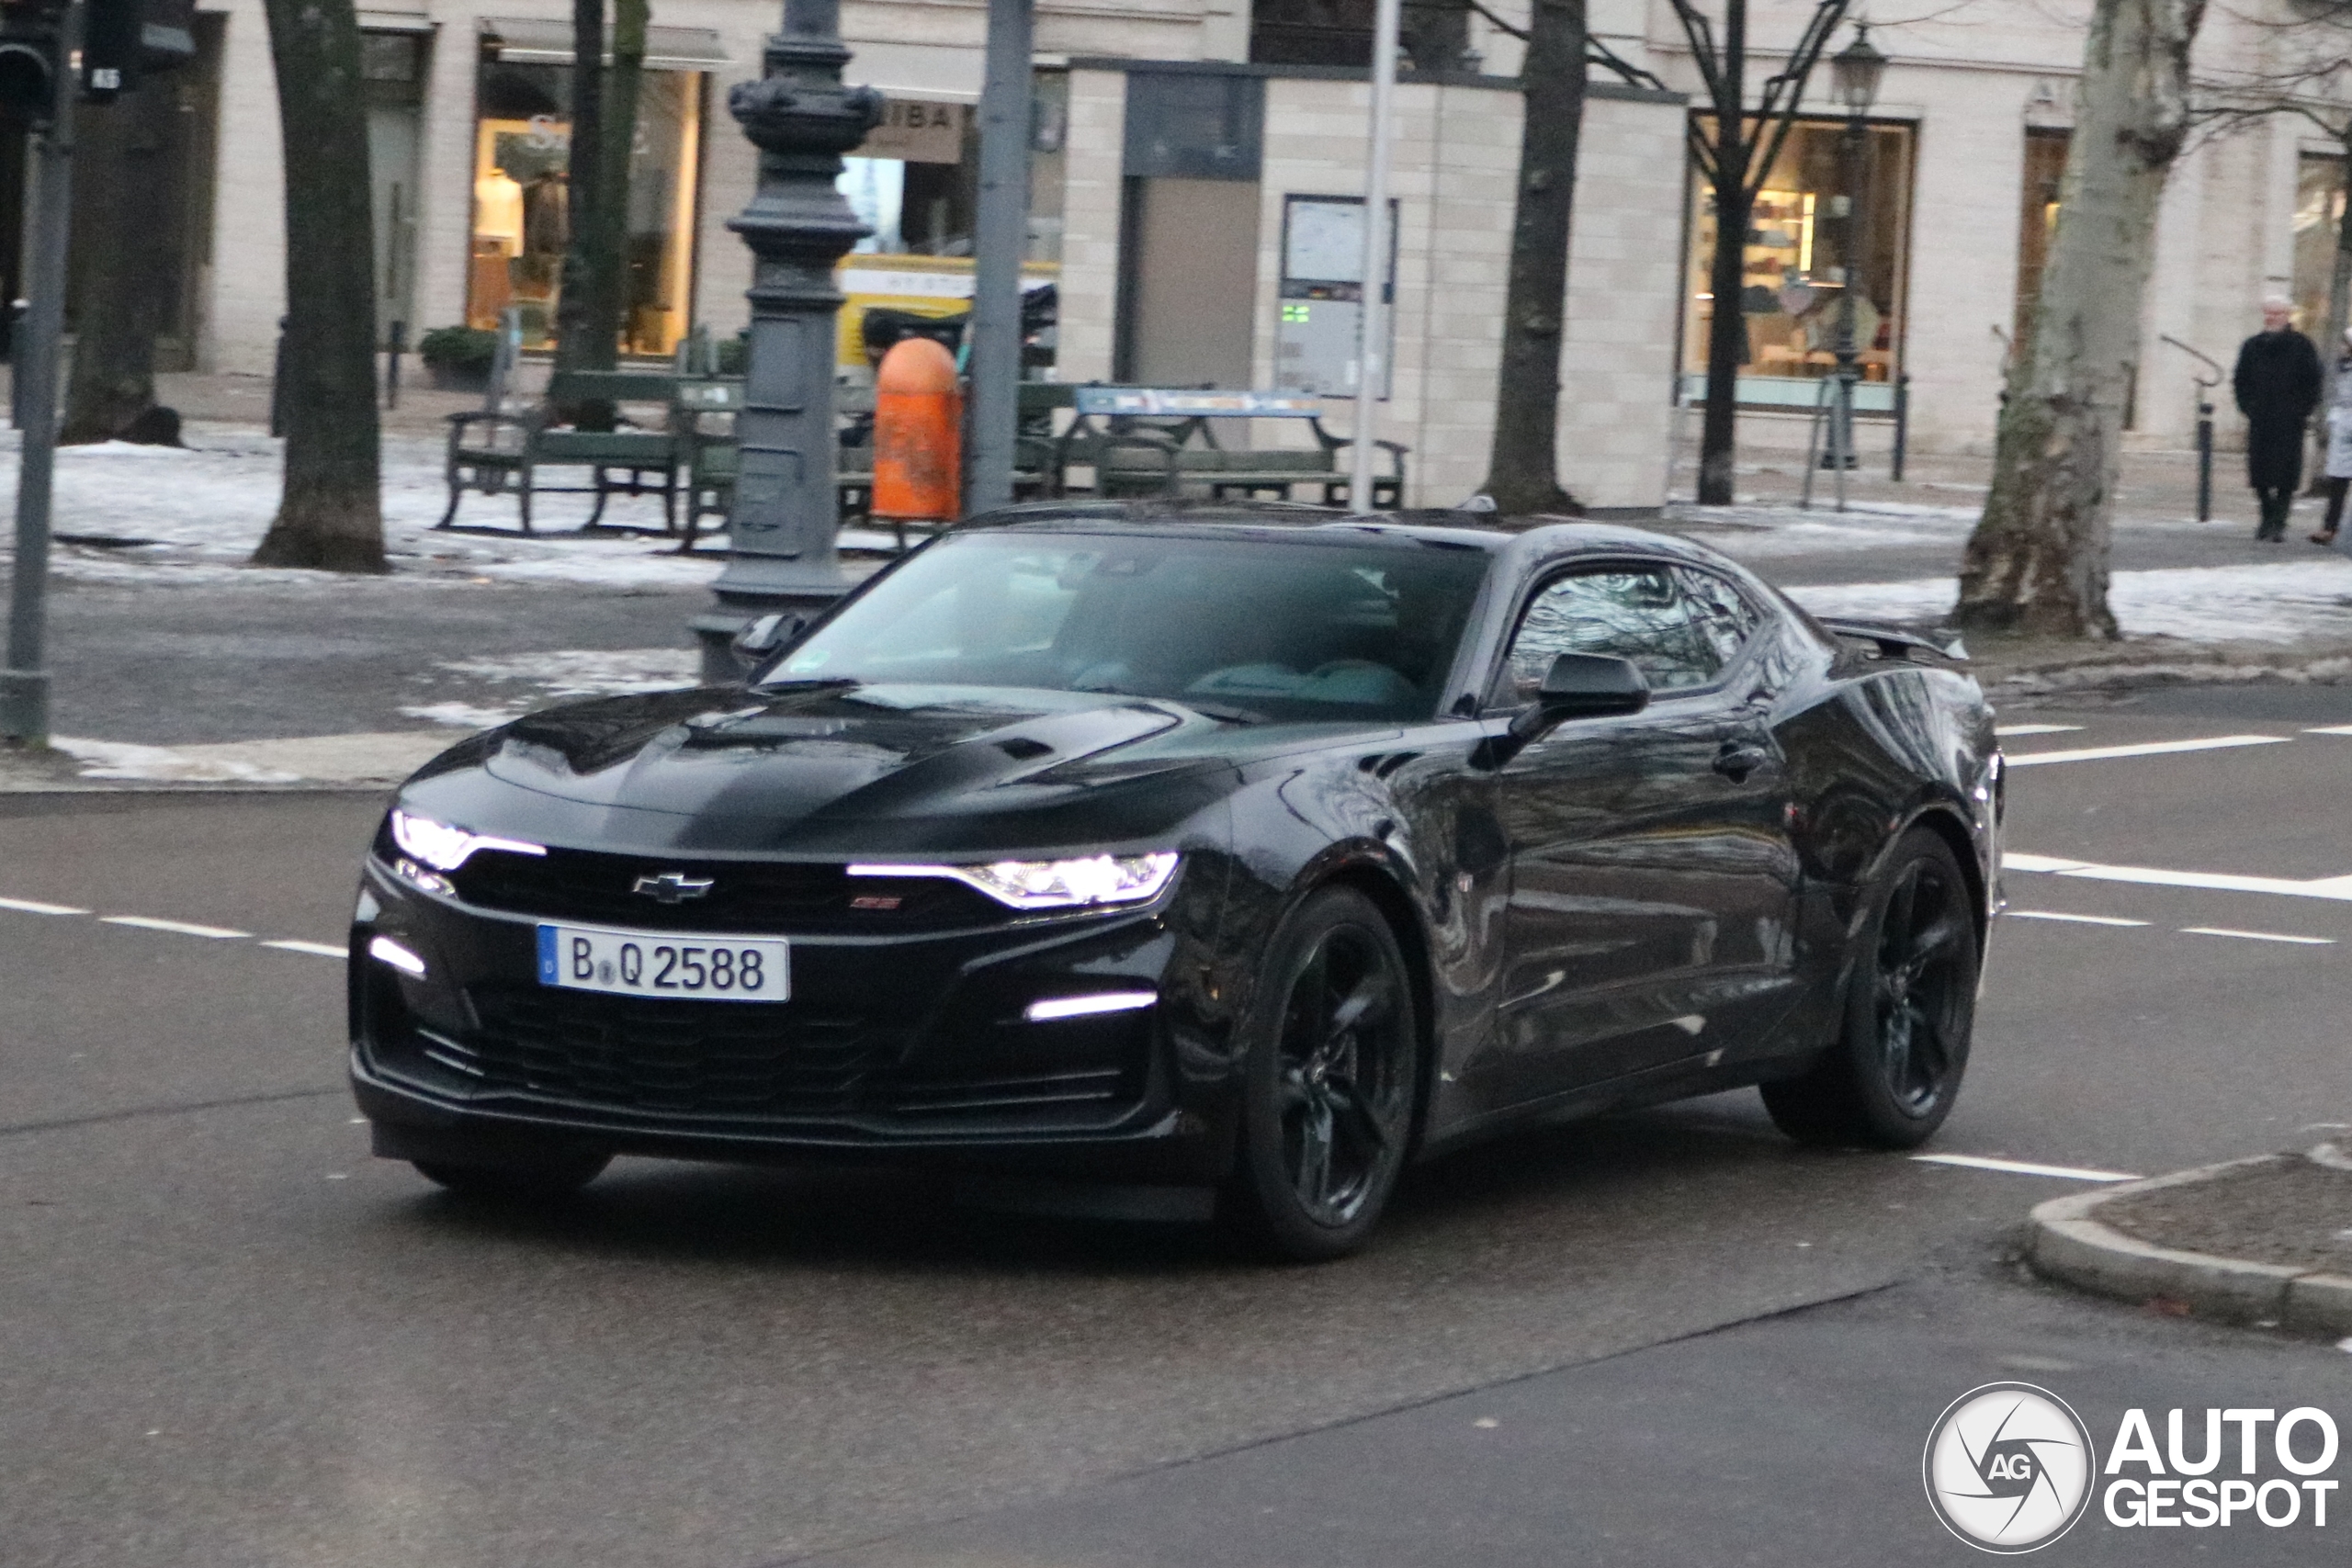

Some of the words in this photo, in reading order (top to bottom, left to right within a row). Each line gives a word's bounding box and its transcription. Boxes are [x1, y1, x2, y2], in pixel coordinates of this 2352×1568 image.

[572, 937, 594, 980] B
[621, 942, 642, 987] Q
[653, 946, 764, 991] 2588
